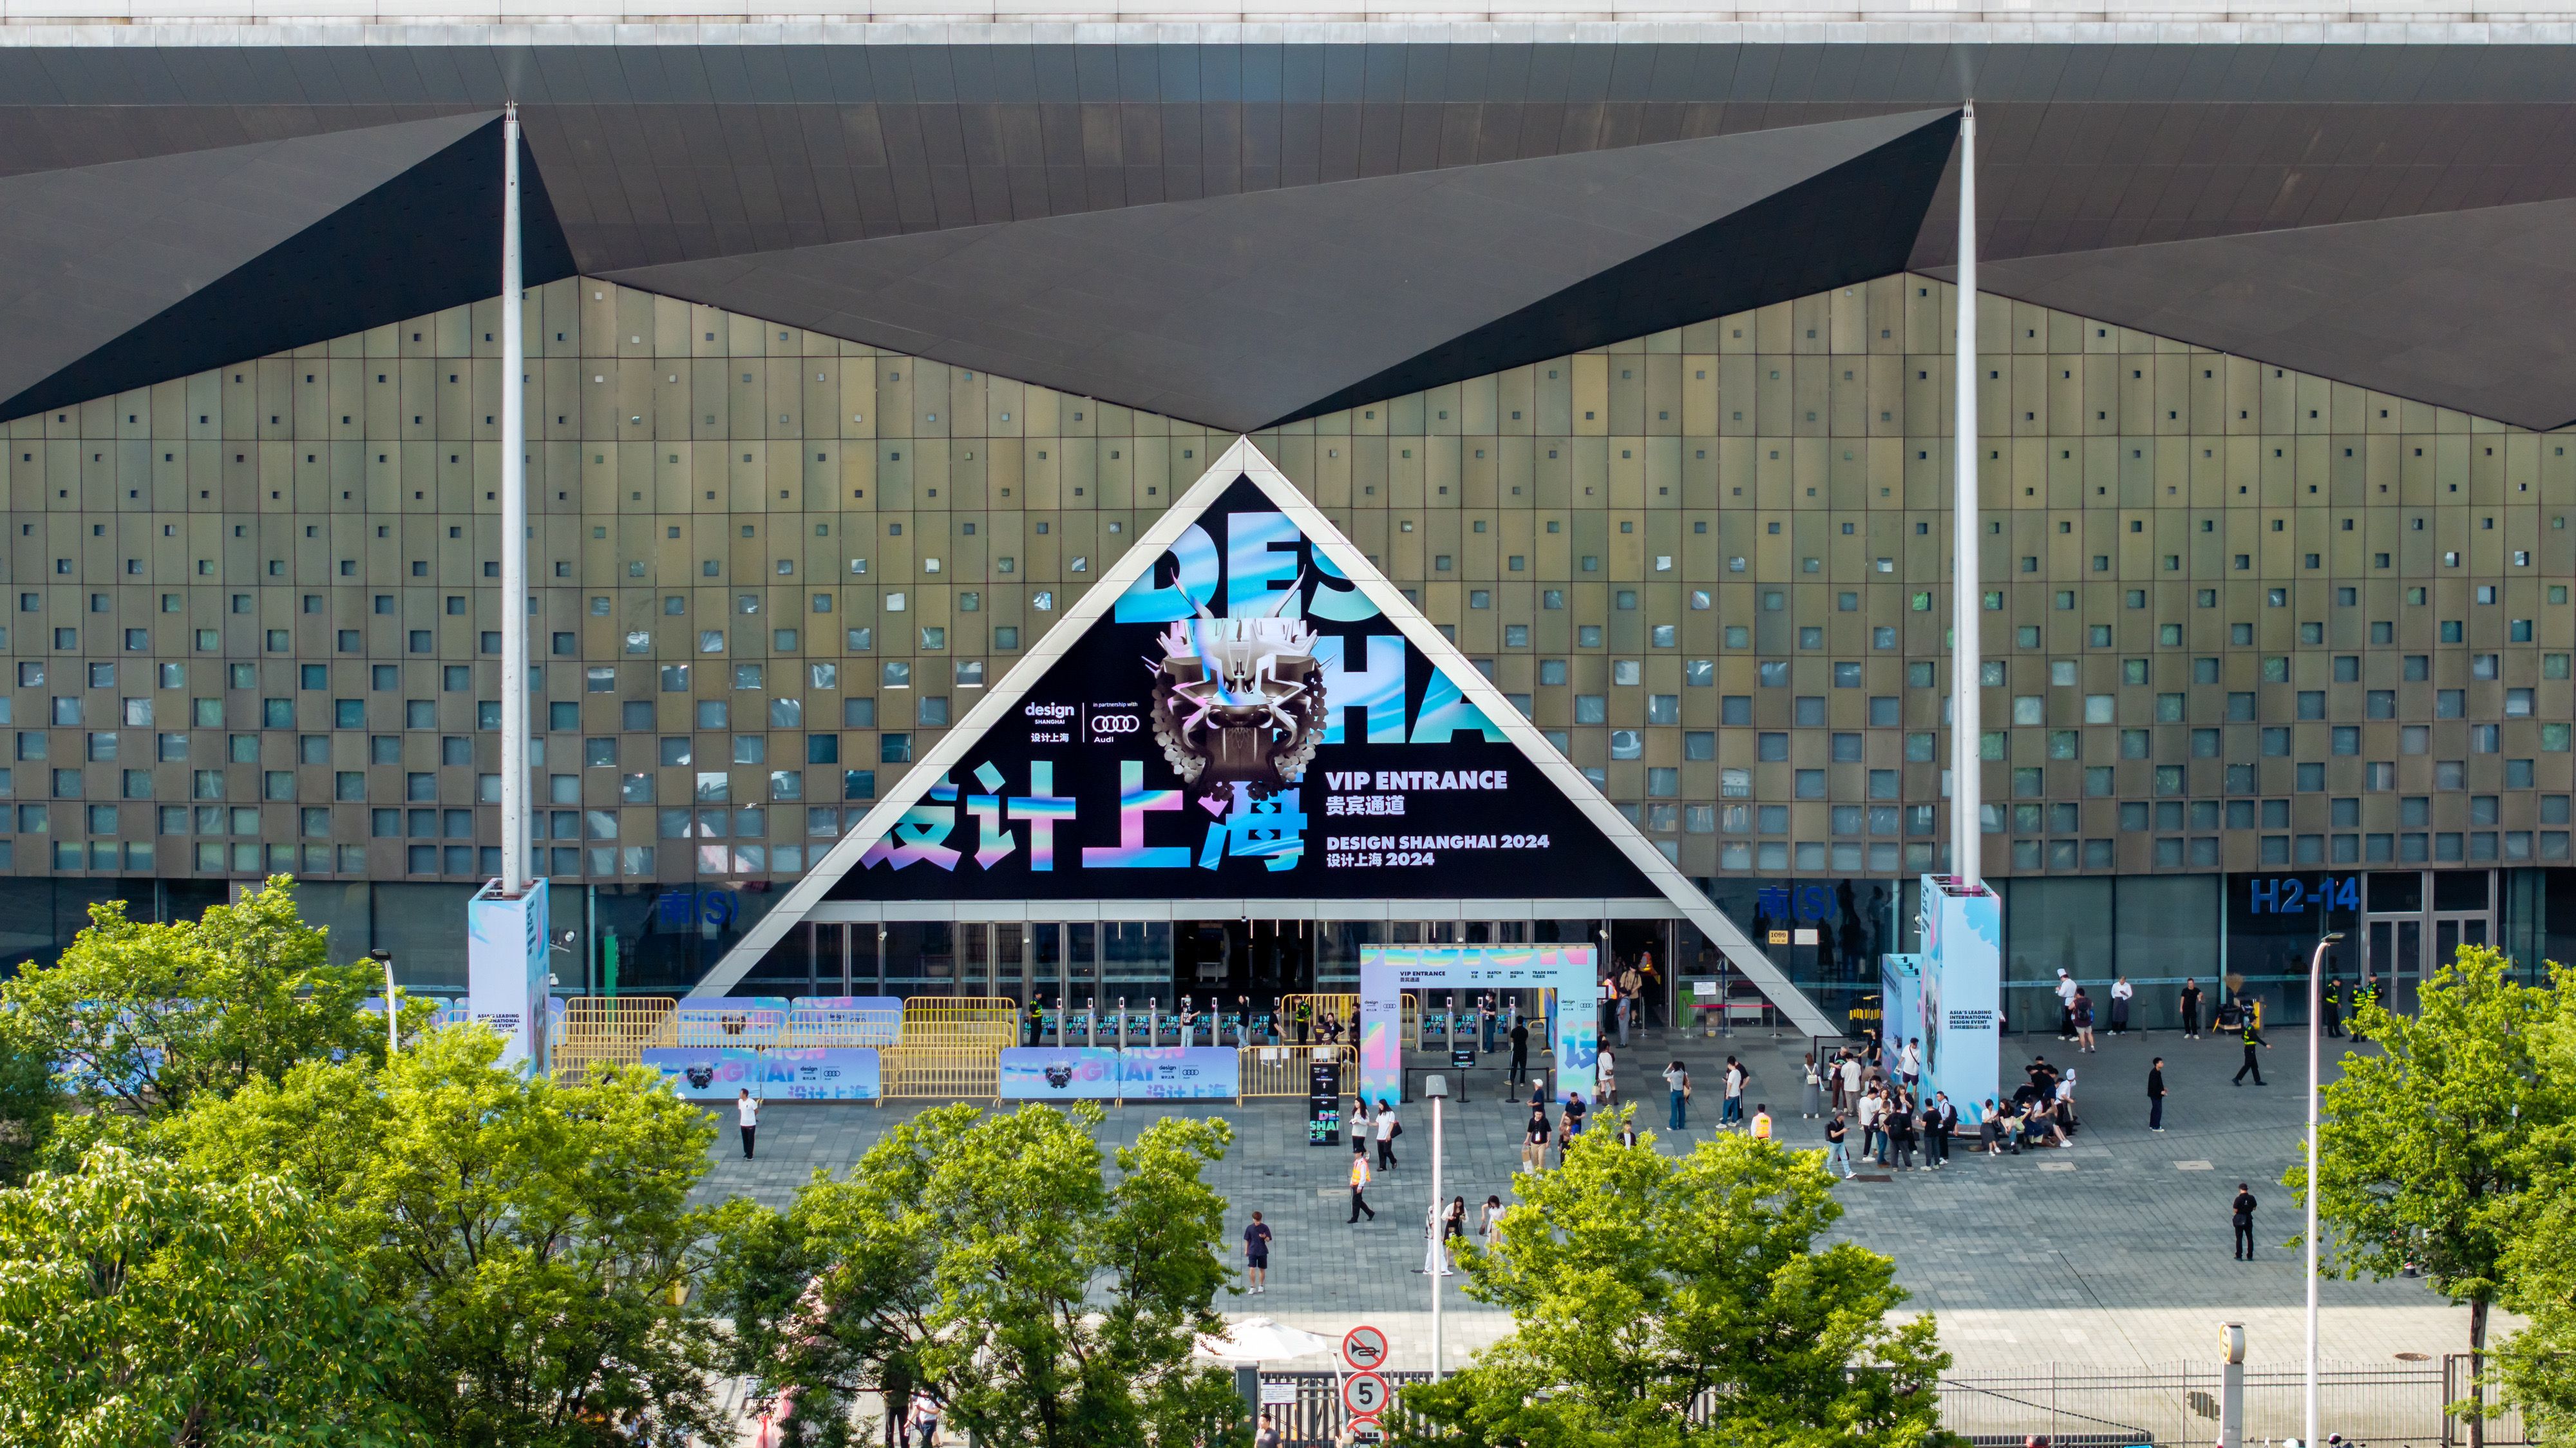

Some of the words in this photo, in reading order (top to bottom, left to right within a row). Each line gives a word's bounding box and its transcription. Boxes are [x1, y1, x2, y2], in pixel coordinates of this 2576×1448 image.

[1025, 702, 1075, 718] design
[1031, 733, 1069, 743] 设计上海
[1325, 772, 1370, 790] VIP
[1376, 771, 1508, 790] ENTRANCE
[1325, 795, 1405, 815] 贵宾通道
[1327, 837, 1395, 850] DESIGN
[1399, 835, 1497, 849] SHANGHAI
[1501, 835, 1549, 848] 2024
[1327, 853, 1382, 868] 设计上海
[1385, 852, 1435, 866] 2024
[2251, 877, 2360, 913] H2-14
[1359, 1382, 1374, 1405] 5
